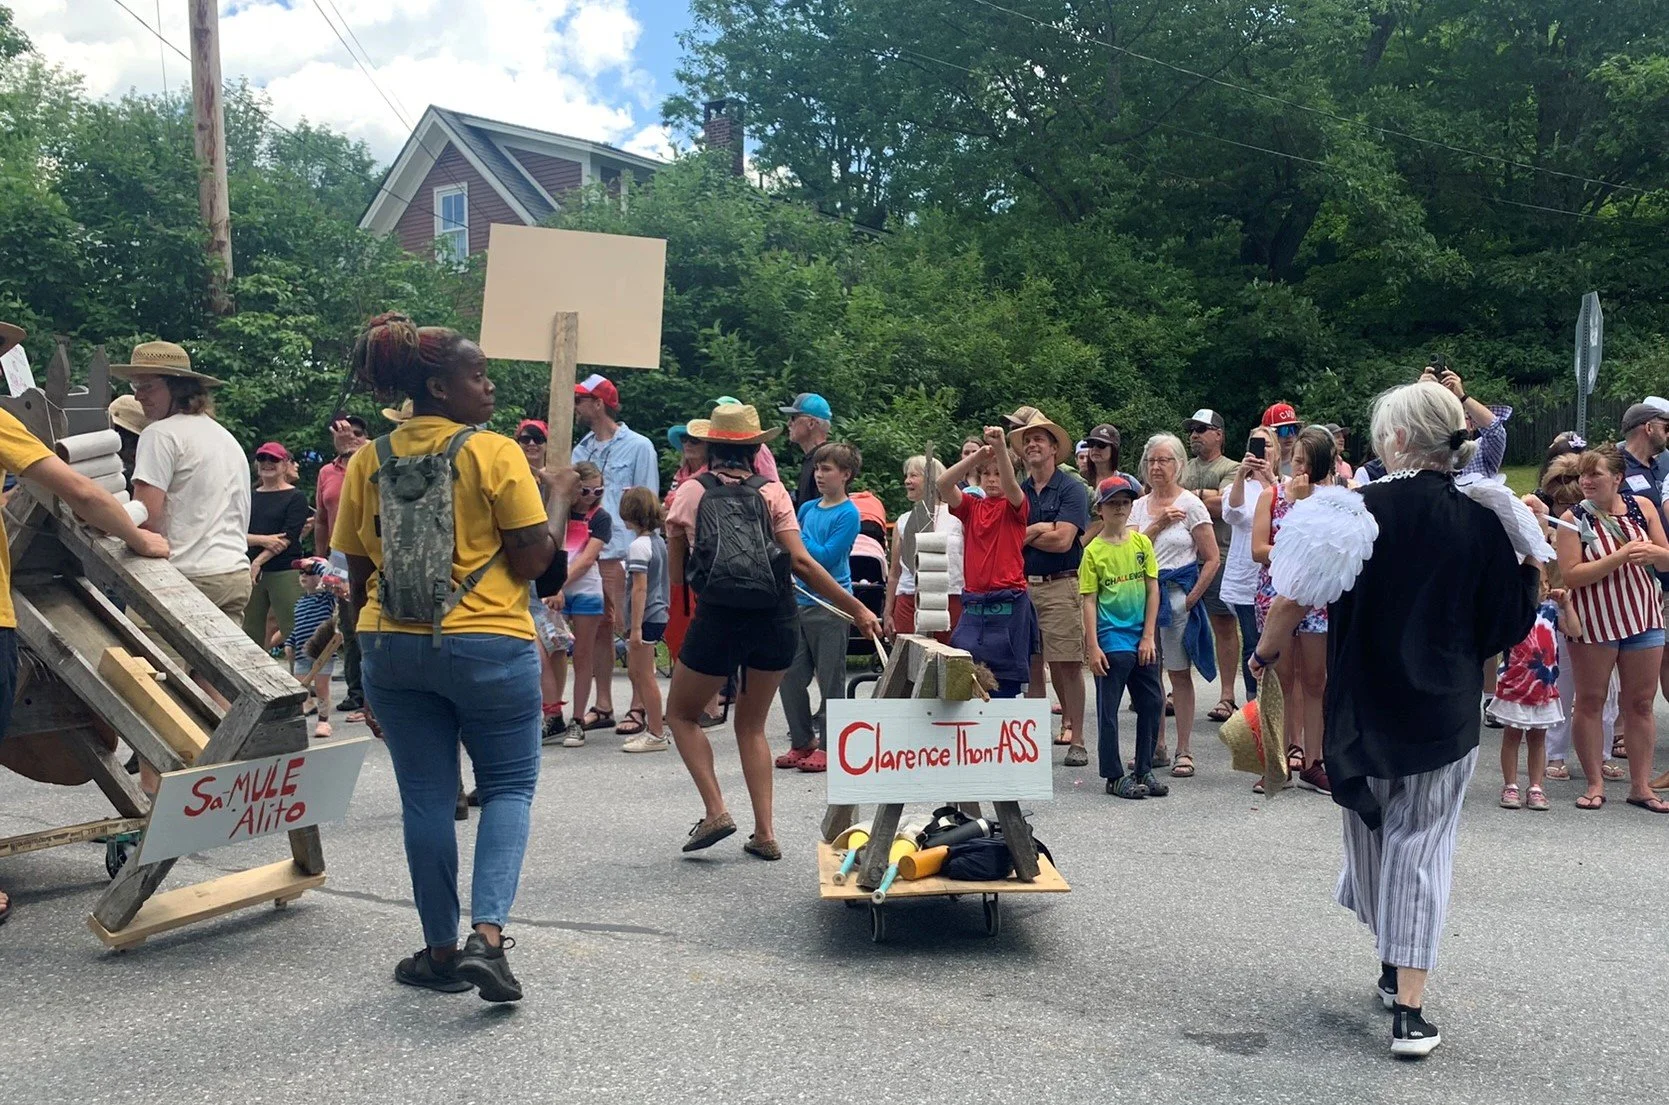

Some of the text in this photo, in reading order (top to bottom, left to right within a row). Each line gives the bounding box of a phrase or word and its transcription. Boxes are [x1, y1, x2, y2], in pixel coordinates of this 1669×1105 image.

[838, 721, 950, 775] Clarence
[184, 757, 305, 817] Sa-MULE
[228, 798, 306, 839] Alito
